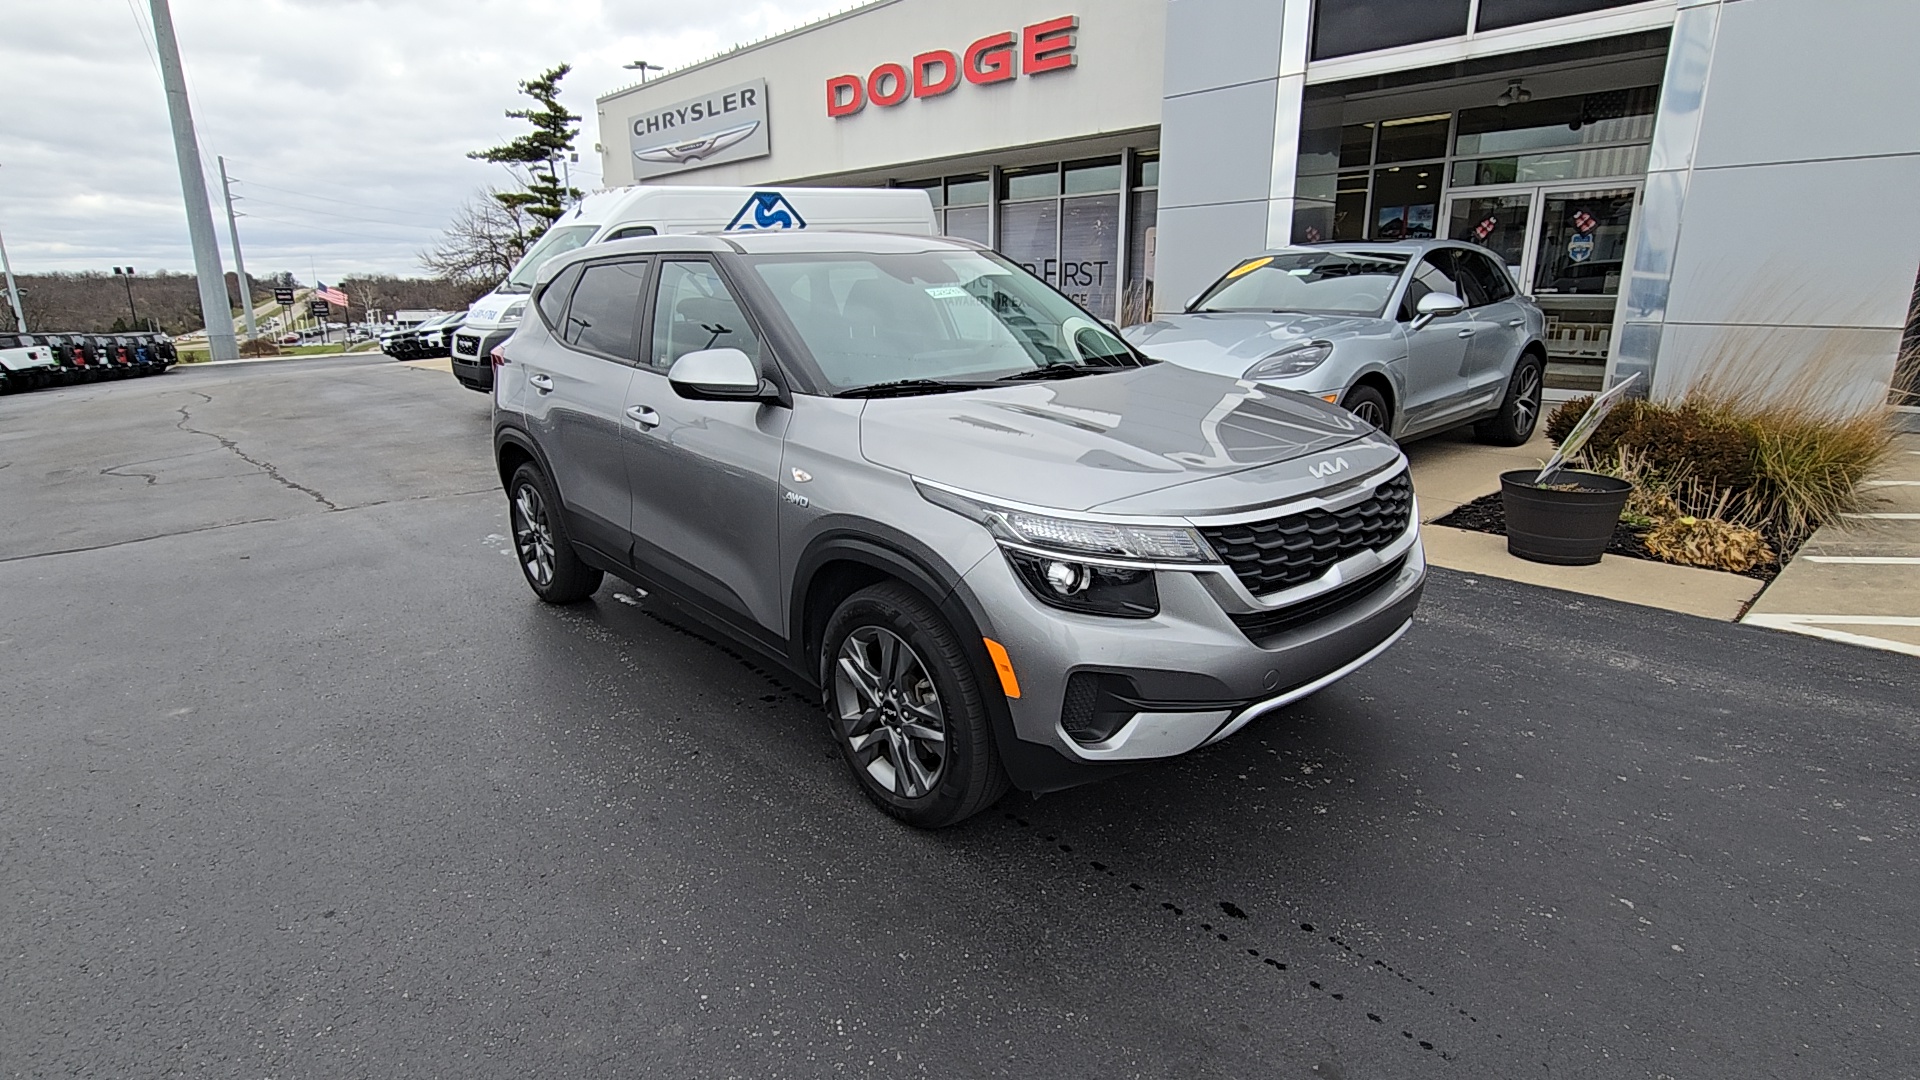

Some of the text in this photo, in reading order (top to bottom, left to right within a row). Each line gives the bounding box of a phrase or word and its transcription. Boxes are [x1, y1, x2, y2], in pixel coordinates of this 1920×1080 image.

[826, 15, 1078, 118] DODGE
[633, 88, 757, 136] CHRYSLER
[1043, 258, 1109, 287] FIRST
[1308, 456, 1349, 479] KIA
[783, 491, 809, 508] AWD
